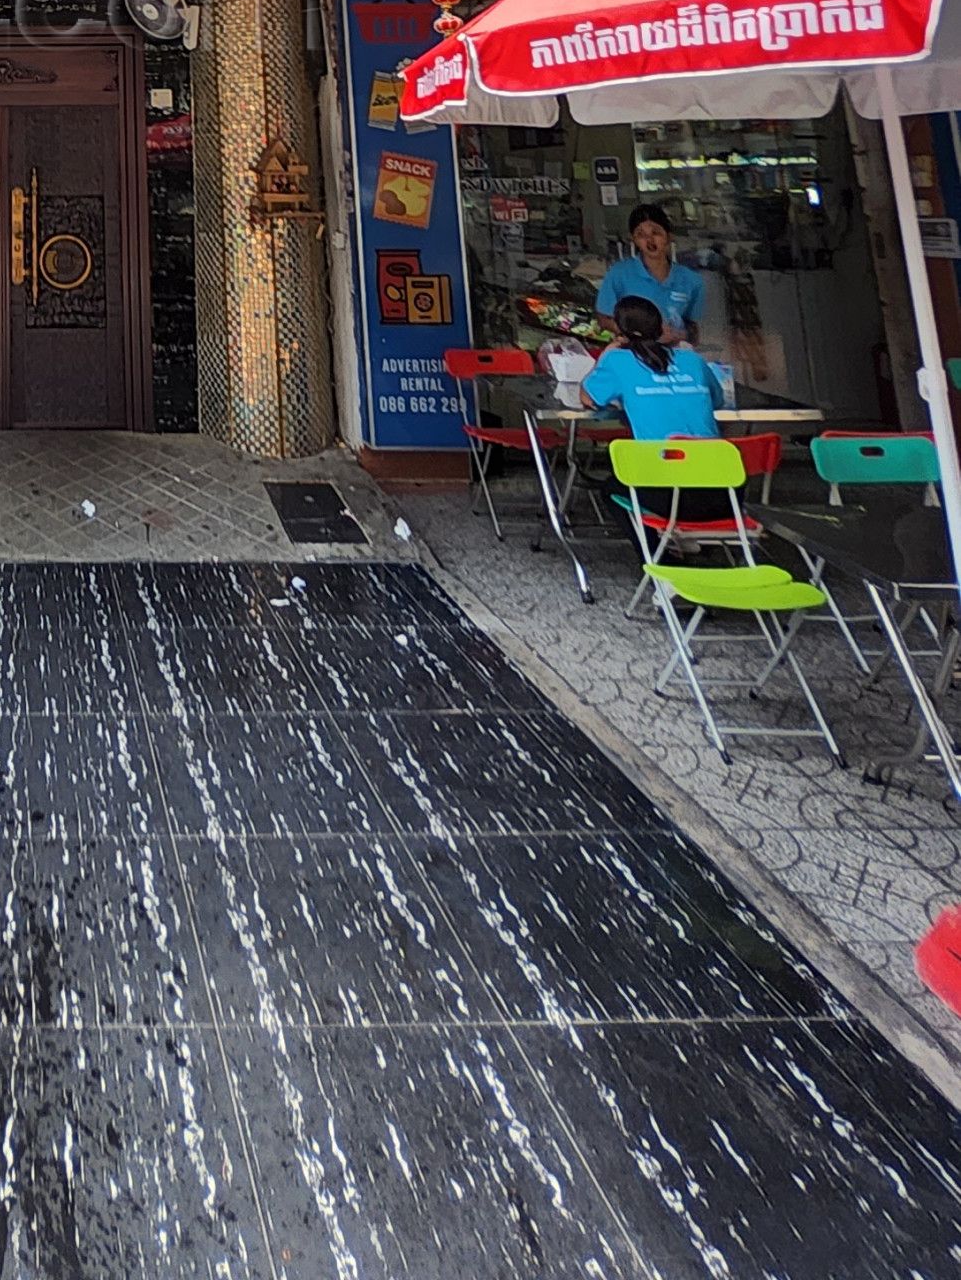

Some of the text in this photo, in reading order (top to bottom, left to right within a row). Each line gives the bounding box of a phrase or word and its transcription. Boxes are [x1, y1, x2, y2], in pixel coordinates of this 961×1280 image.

[385, 158, 431, 178] SNACK
[382, 358, 448, 373] ADVERTISI
[400, 377, 445, 392] RENTAL
[379, 396, 466, 413] 086 662 29
